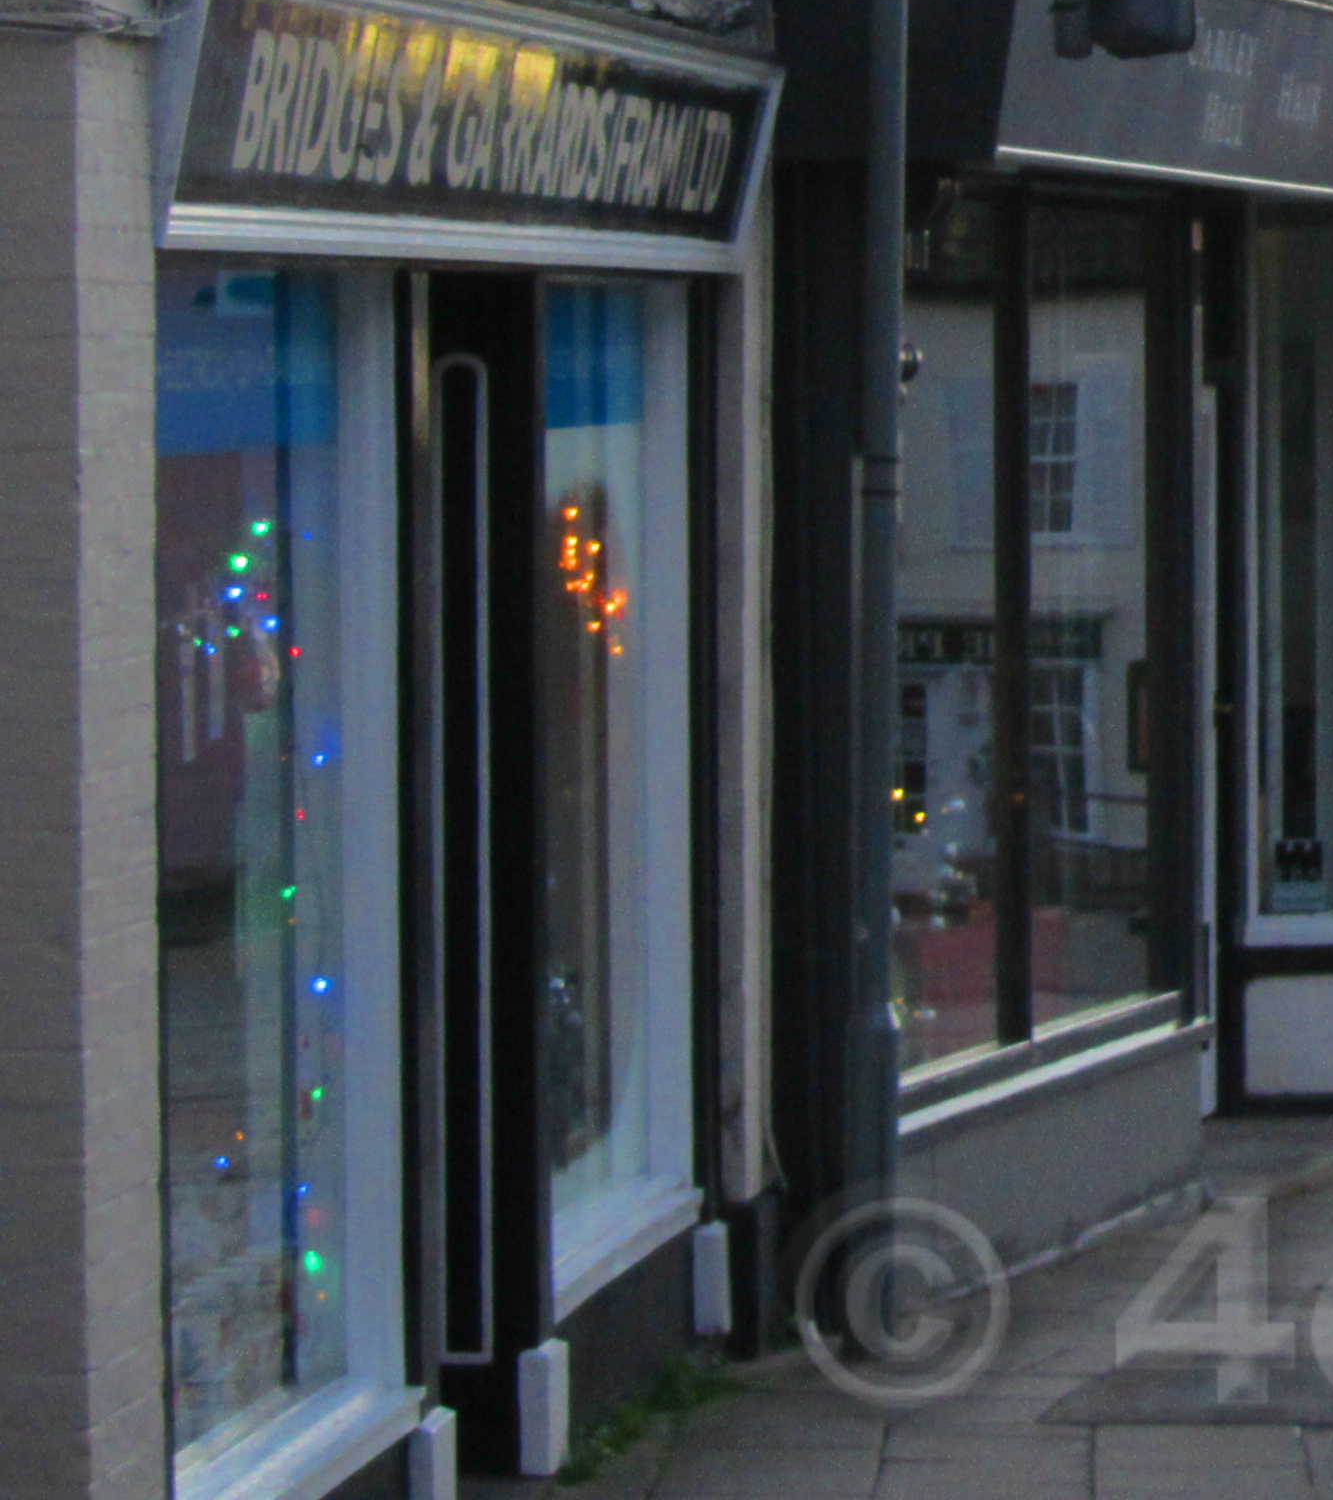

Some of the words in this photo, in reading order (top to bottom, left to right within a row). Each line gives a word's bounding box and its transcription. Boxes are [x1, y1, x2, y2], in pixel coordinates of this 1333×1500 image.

[231, 27, 403, 186] BRIDGES
[407, 56, 442, 187] &
[681, 105, 732, 214] LTD
